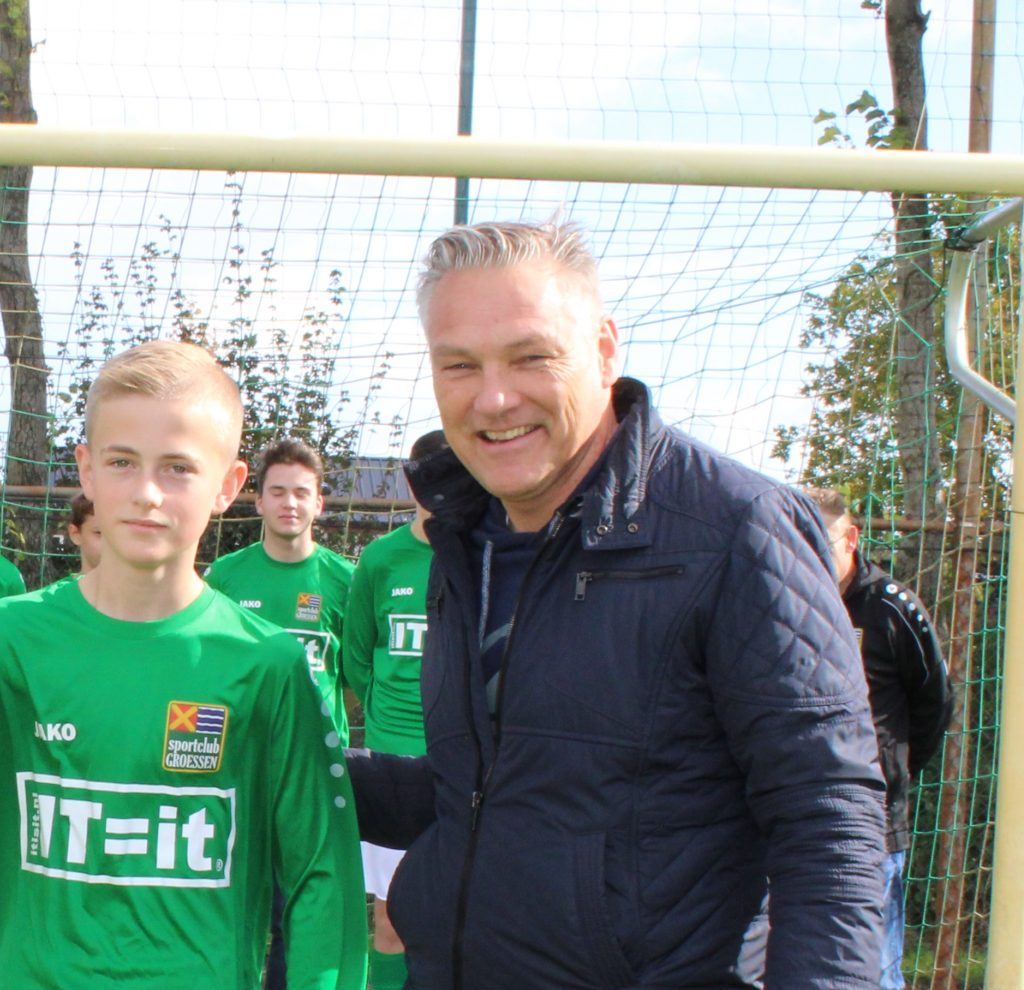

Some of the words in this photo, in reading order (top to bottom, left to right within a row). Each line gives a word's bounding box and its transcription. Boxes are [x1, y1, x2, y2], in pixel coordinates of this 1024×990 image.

[391, 587, 414, 597] JAKO
[34, 721, 76, 742] JAKO
[168, 736, 220, 755] sportclub
[166, 752, 218, 769] GROESSEN
